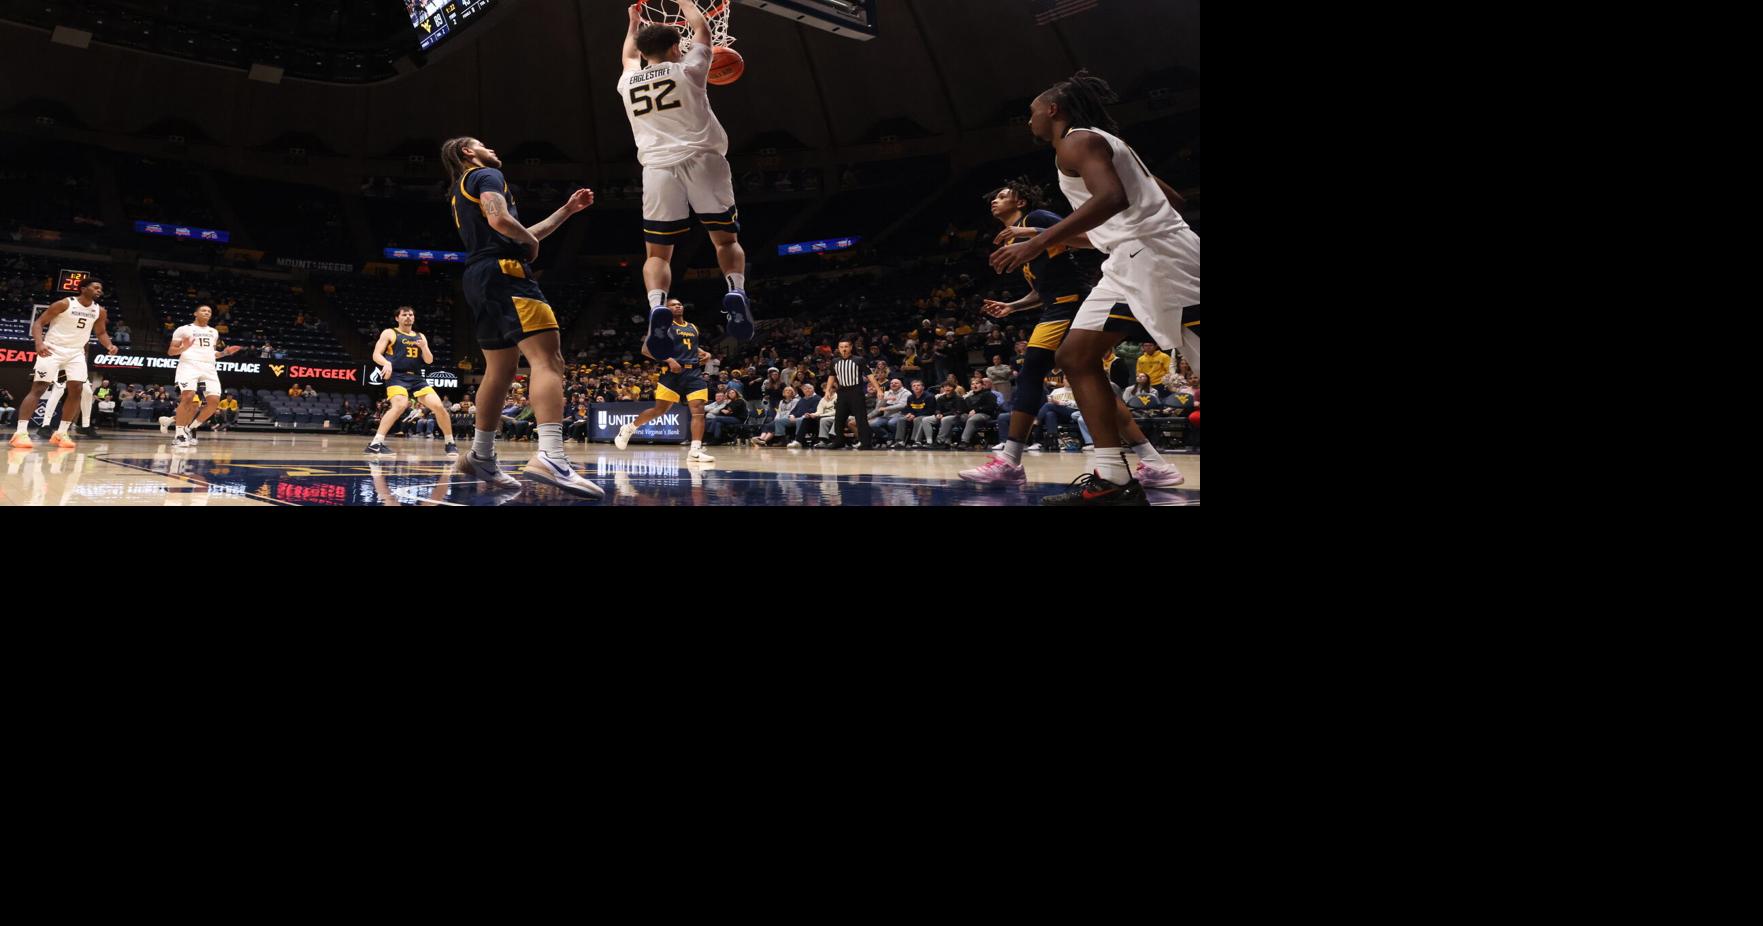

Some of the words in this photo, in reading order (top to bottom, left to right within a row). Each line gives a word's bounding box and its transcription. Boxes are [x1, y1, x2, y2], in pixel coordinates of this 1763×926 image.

[629, 79, 681, 117] 52
[77, 318, 86, 329] 5
[199, 338, 210, 347] 15
[683, 338, 692, 350] 4
[0, 348, 37, 362] SEAT
[406, 347, 418, 358] 33
[94, 354, 144, 366] OFFICIAL
[146, 357, 179, 369] TICKE
[216, 361, 261, 373] ETPLACE
[289, 365, 357, 381] SEATGEEK
[608, 414, 640, 426] UNITE
[649, 414, 679, 426] BANK
